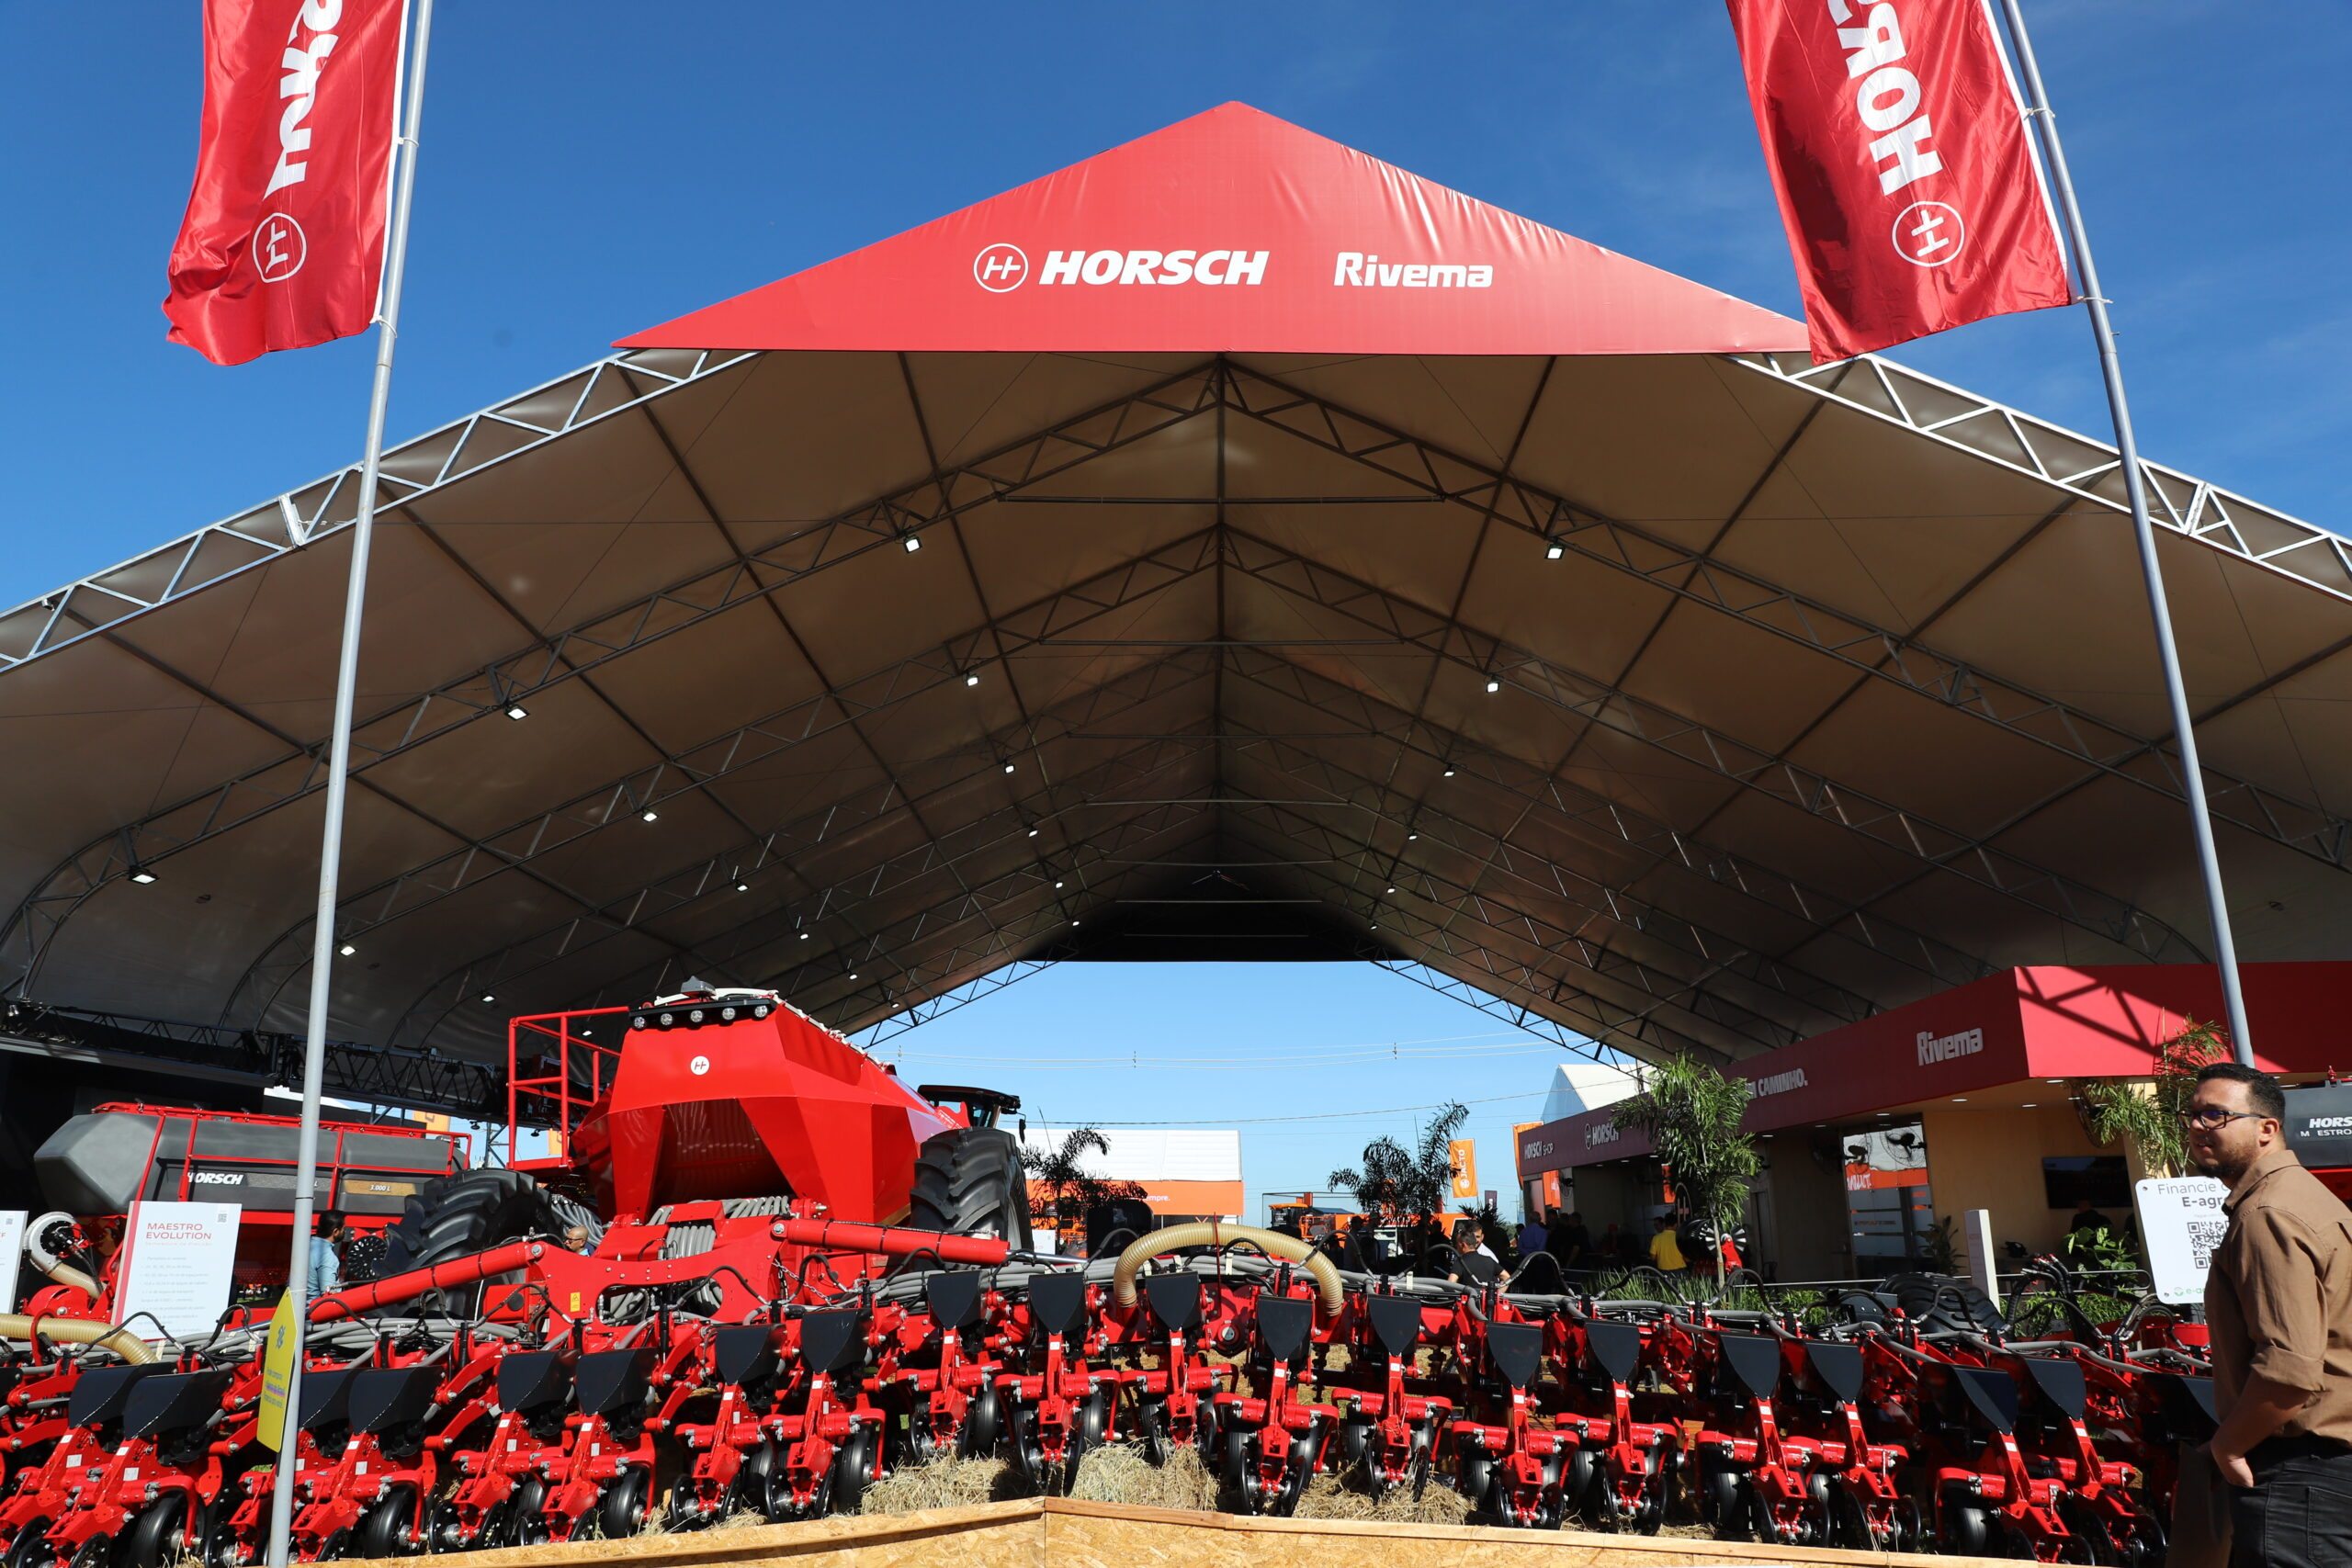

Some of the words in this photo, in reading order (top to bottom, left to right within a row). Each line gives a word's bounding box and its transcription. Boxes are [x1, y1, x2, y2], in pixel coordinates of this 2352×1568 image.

[1039, 250, 1270, 286] HORSCH
[1334, 252, 1493, 288] Rivema
[1917, 1028, 1984, 1066] Rivema
[1758, 1068, 1808, 1097] CAMINHO.
[1524, 1141, 1542, 1159] HORSCH
[1458, 1149, 1468, 1178] JACTO
[2157, 1181, 2216, 1195] Financie
[2182, 1196, 2225, 1209] E-agr
[145, 1231, 212, 1240] EVOLUTION
[147, 1223, 203, 1231] MAESTRO
